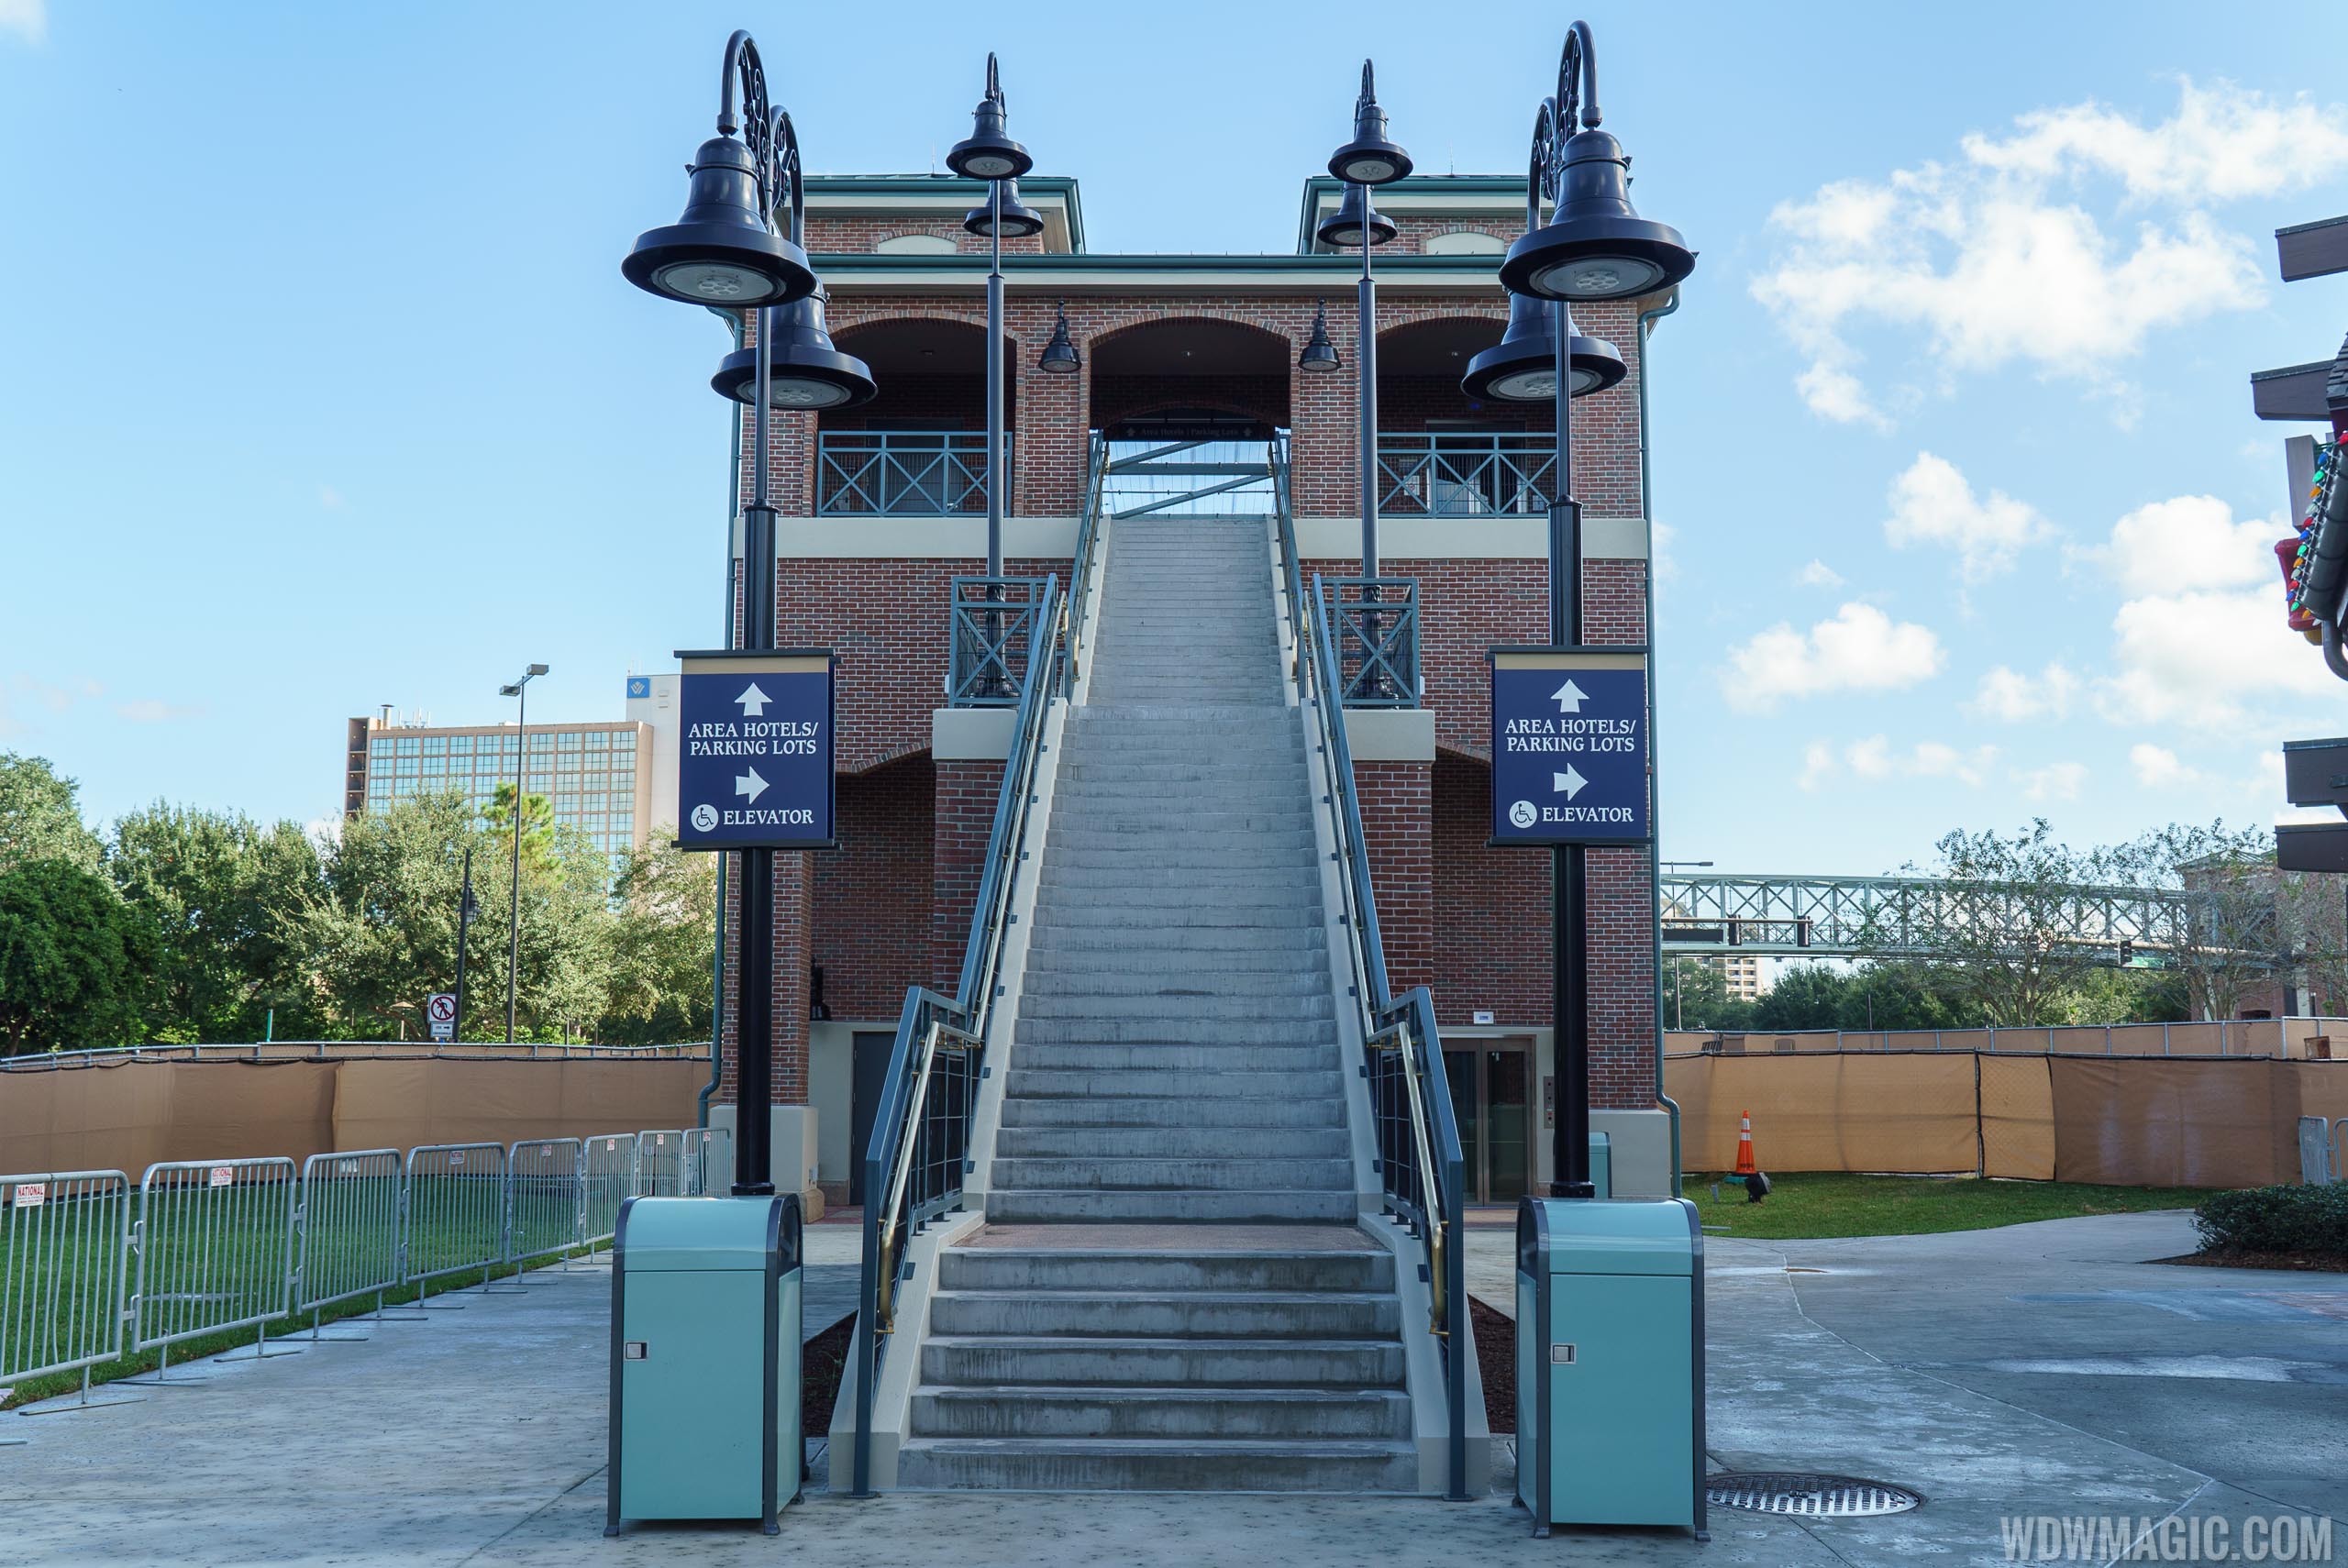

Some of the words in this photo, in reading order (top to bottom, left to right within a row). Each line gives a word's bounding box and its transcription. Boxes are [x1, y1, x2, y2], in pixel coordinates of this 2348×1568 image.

[688, 723, 738, 738] AREA
[744, 722, 819, 737] HOTELS/
[1505, 718, 1556, 734] AREA
[1561, 719, 1636, 734] HOTELS/
[690, 740, 767, 756] PARKING
[772, 740, 817, 755] LOTS
[1507, 737, 1584, 752] PARKING
[1590, 737, 1635, 752] LOTS
[723, 810, 814, 825] ELEVATOR
[1542, 807, 1634, 822] ELEVATOR
[17, 1186, 43, 1197] NATIONAL
